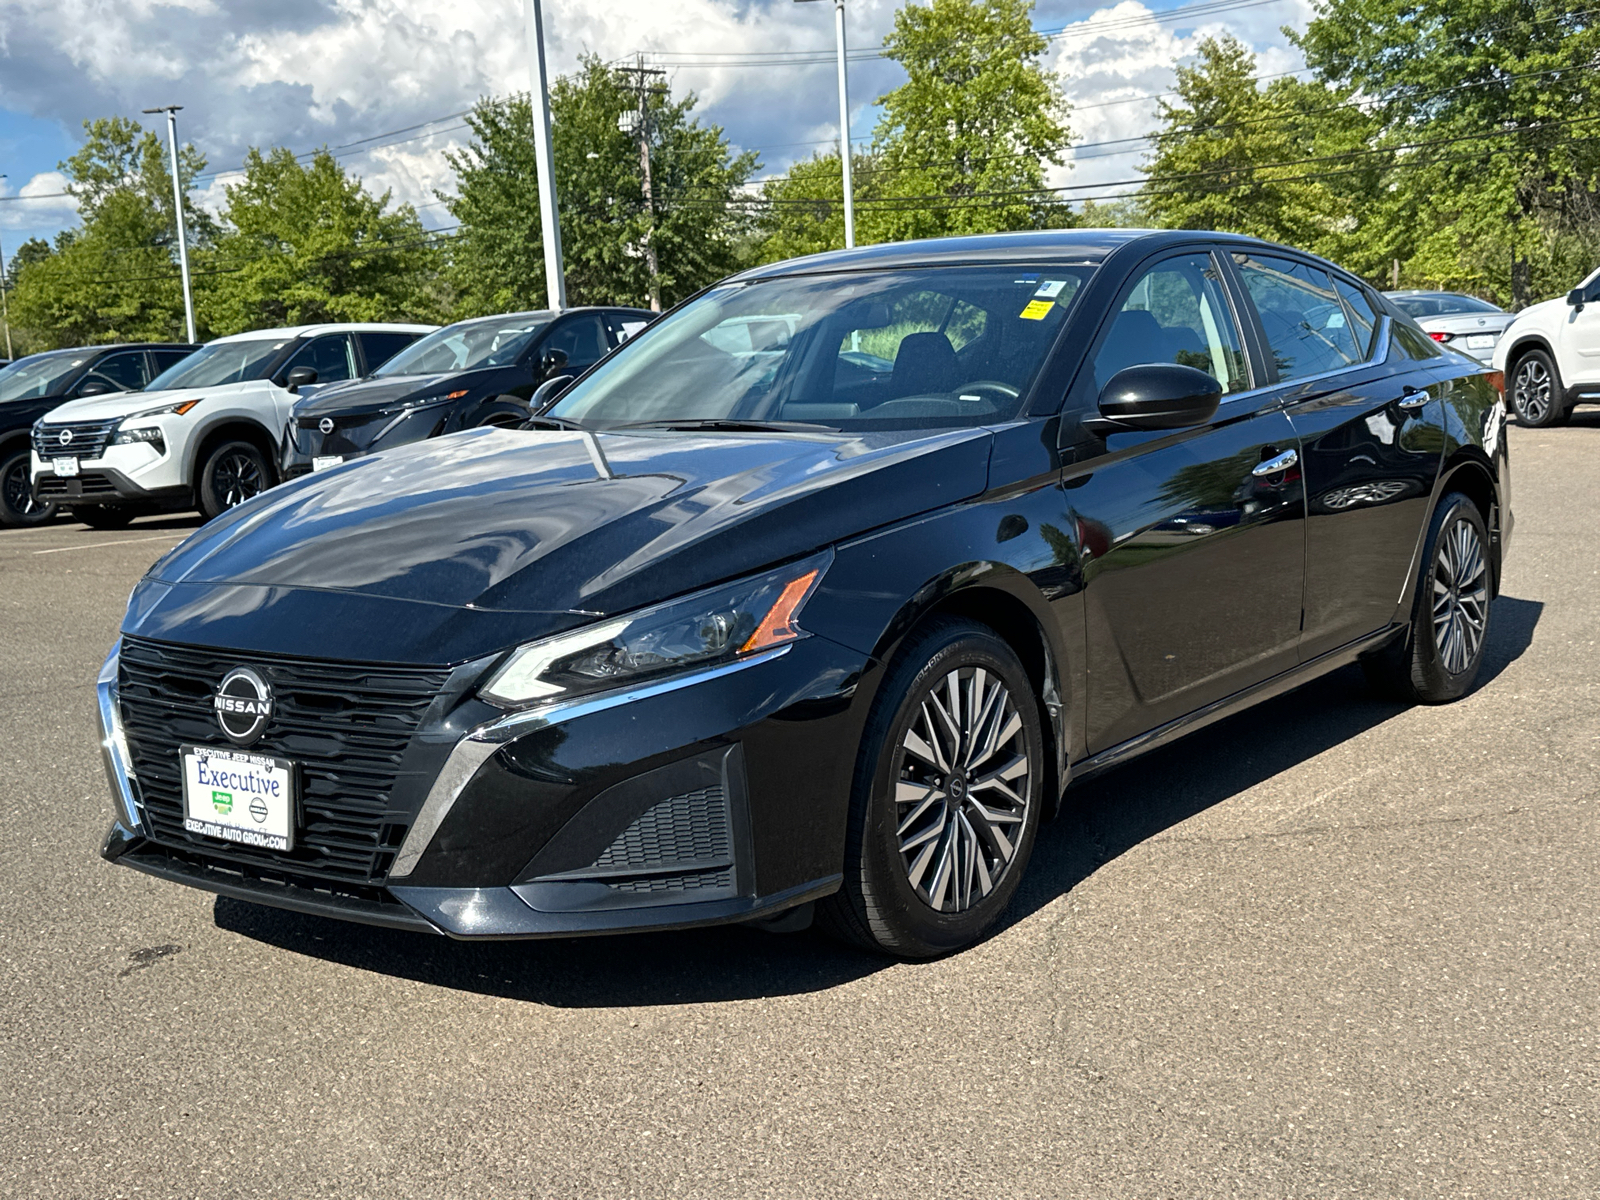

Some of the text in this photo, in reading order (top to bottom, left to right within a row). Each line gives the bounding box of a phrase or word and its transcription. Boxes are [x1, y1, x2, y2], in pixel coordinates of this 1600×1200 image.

[214, 696, 270, 715] NISSAN
[193, 747, 275, 768] EXECUTIVE JEEP NISSAN
[197, 760, 280, 797] Executive
[215, 792, 231, 804] Jeep
[185, 818, 222, 838] EXECUTIVE
[222, 827, 242, 842] AUTO
